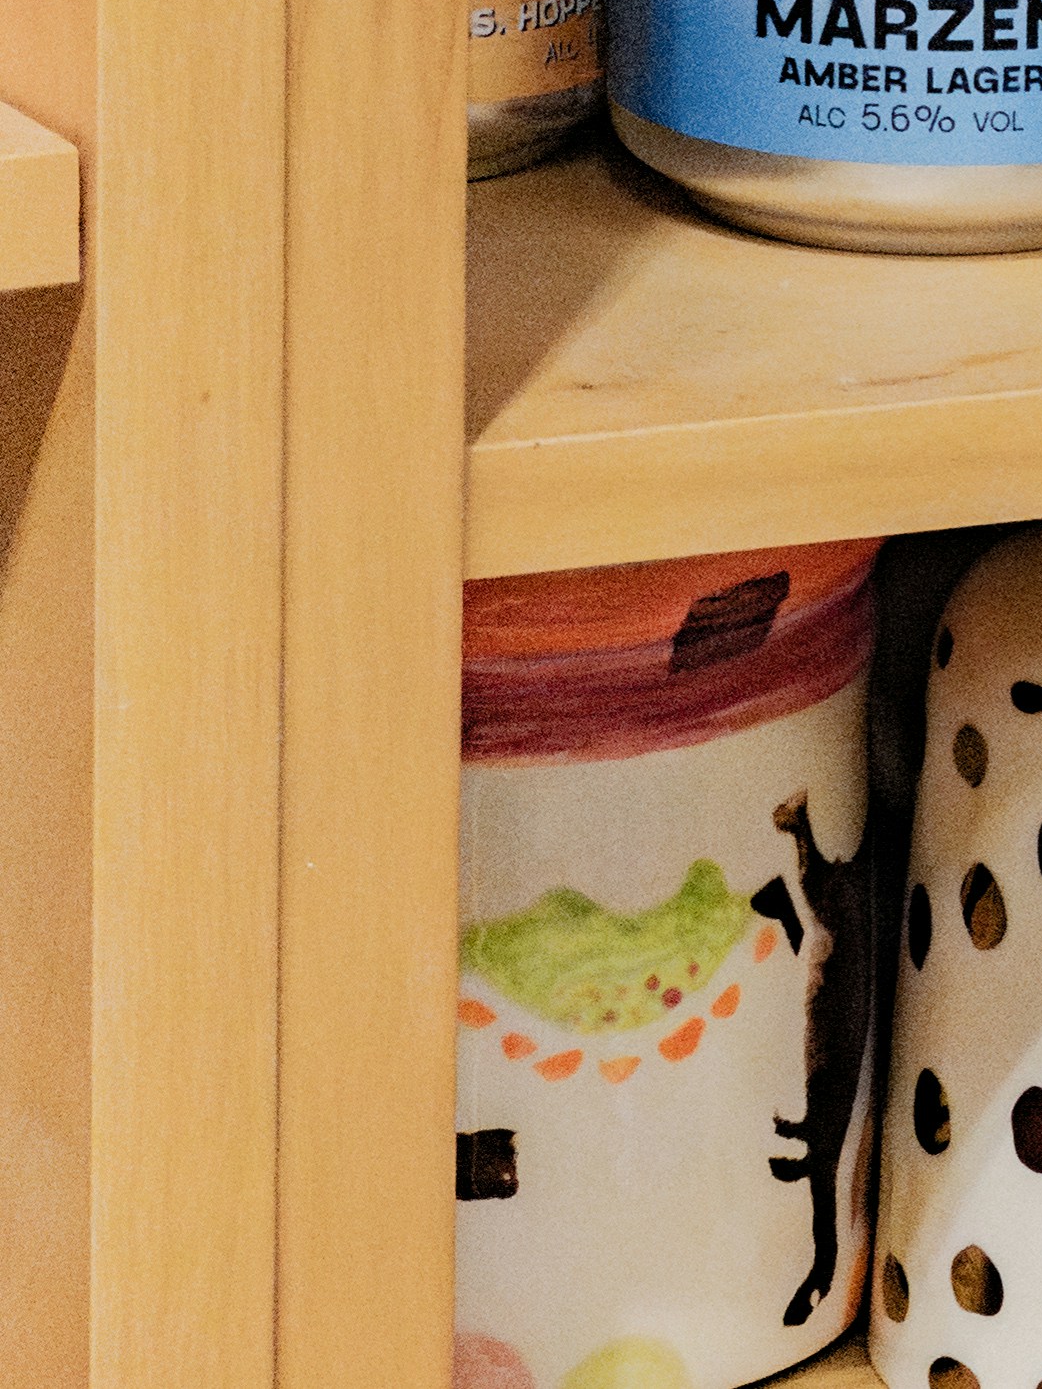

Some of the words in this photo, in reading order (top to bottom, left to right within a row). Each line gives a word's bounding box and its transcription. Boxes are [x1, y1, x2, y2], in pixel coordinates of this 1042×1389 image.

[779, 57, 907, 94] AMBER
[798, 105, 845, 129] ALC
[861, 103, 956, 133] 5.6%
[973, 110, 1025, 133] VOL
